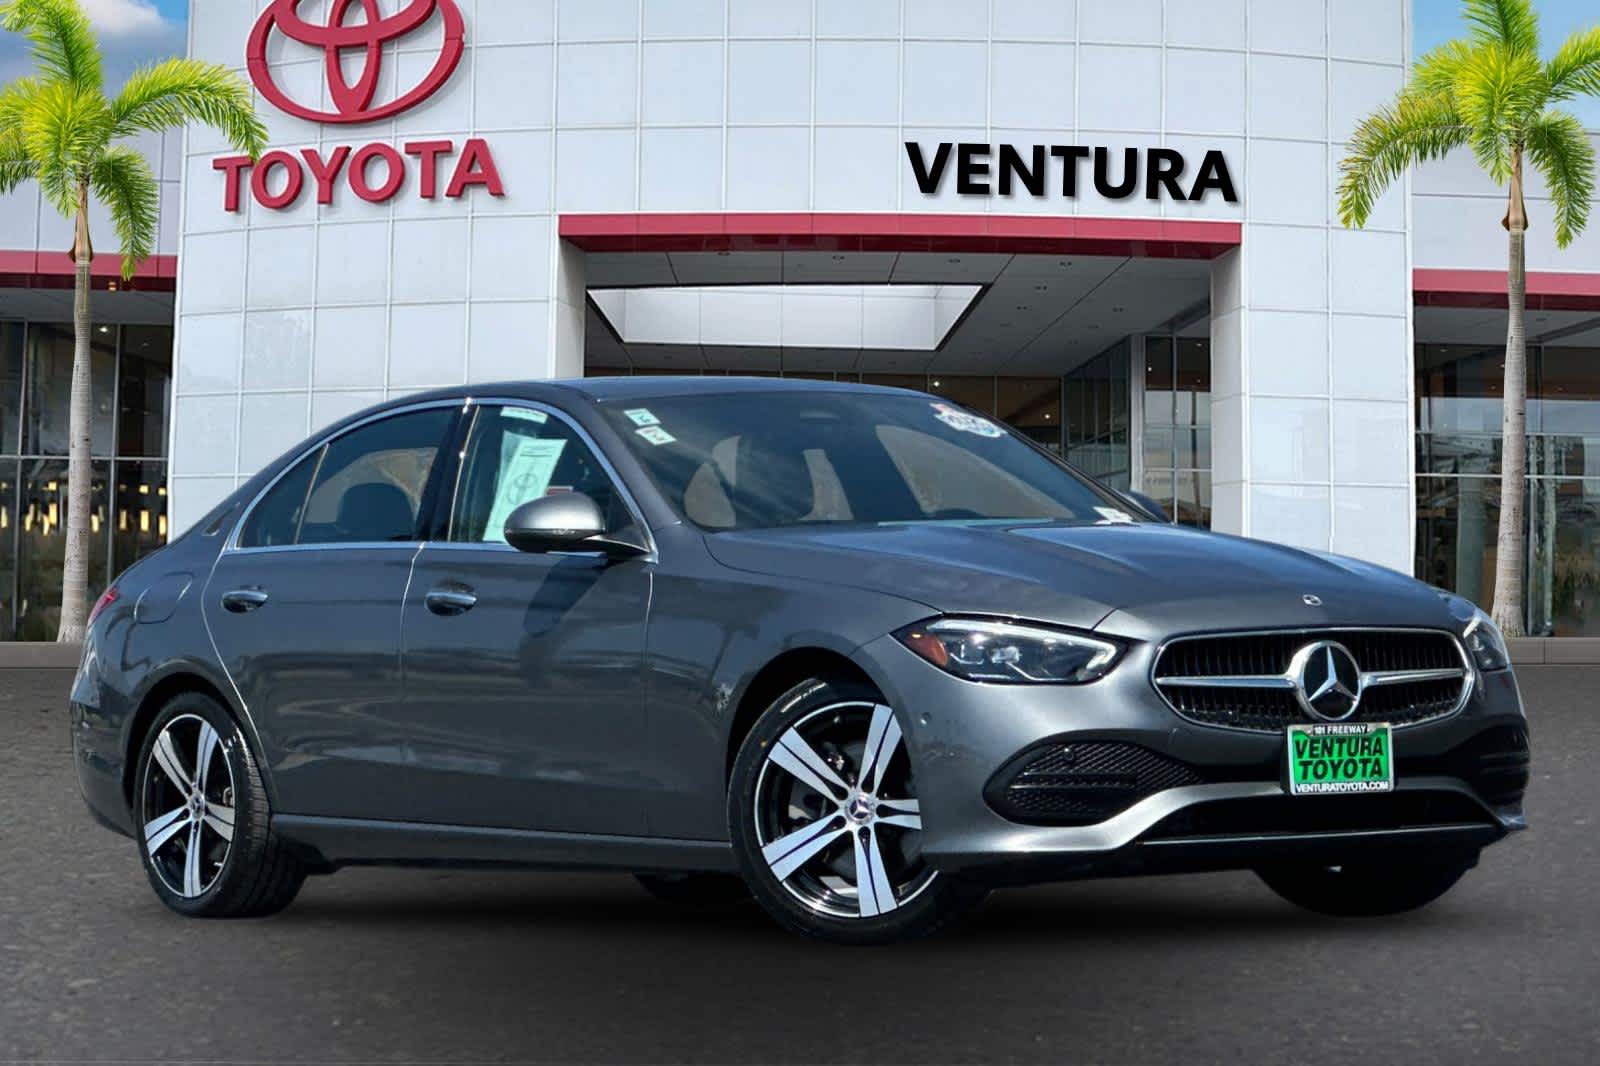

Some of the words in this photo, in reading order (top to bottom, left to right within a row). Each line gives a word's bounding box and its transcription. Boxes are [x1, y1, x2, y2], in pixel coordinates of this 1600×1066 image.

[213, 138, 505, 212] TOYOTA
[905, 142, 1240, 203] VENTURA
[1327, 725, 1367, 735] FREEWAY
[1295, 736, 1383, 759] VENTURA
[1299, 757, 1384, 780] TOYOTA
[1295, 781, 1389, 794] VENTURATOYOTA.COM
